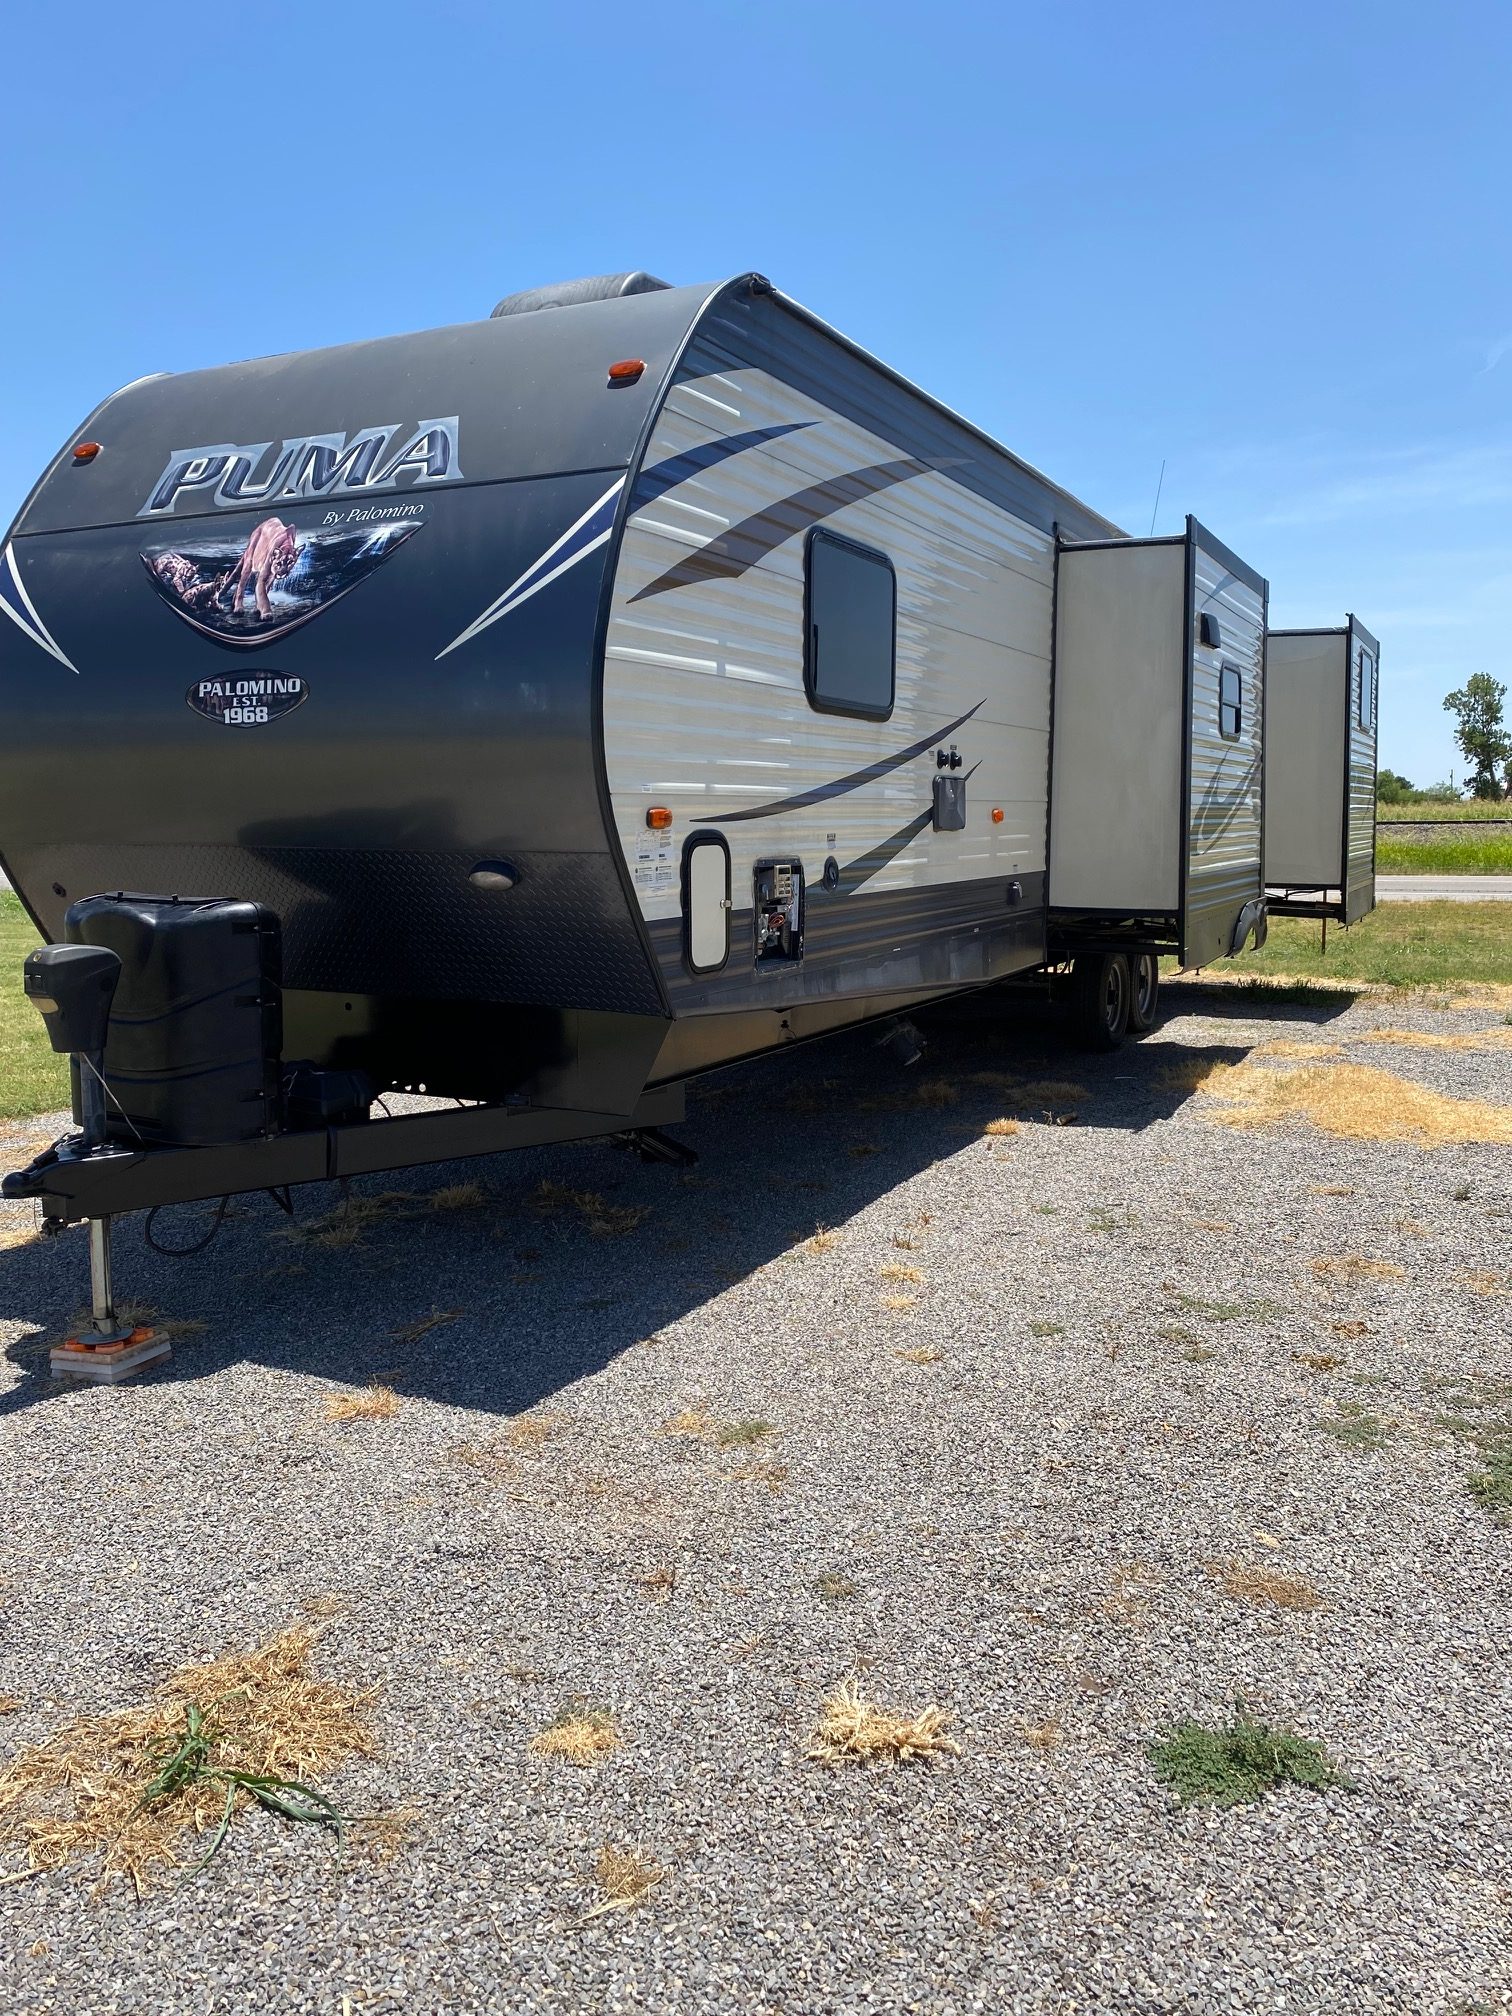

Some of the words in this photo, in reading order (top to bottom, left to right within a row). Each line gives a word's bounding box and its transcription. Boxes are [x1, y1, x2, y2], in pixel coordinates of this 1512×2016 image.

[137, 416, 464, 516] PUMA
[321, 511, 345, 526] By
[345, 503, 424, 522] Palomino
[199, 678, 301, 697] PALOMINO
[232, 697, 261, 707] EST.
[223, 706, 269, 724] 1968
